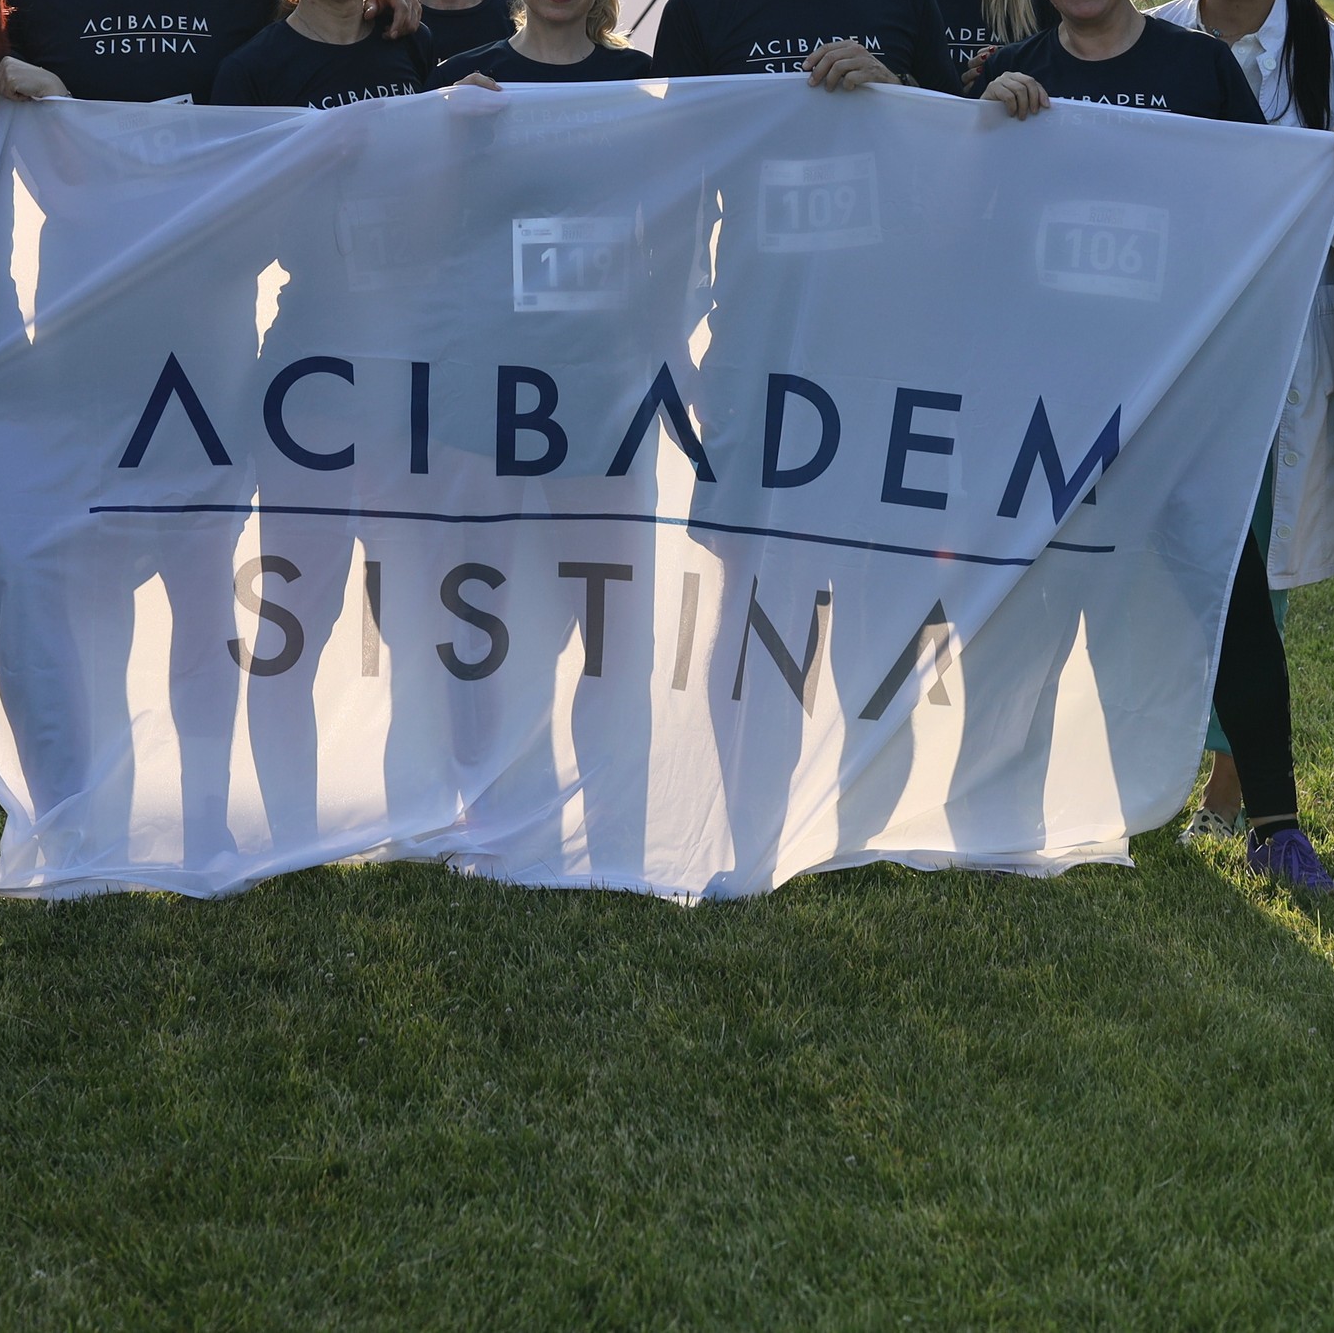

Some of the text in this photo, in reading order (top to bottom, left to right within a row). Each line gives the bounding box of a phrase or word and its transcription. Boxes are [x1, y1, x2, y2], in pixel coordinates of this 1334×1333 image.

[83, 15, 209, 34] ACIBADEM
[94, 37, 197, 55] SISTINA
[782, 185, 857, 229] 109
[540, 247, 614, 288] 119
[1064, 228, 1143, 274] 106
[118, 351, 1123, 523] ACIBADEM
[225, 554, 955, 720] SISTINA
